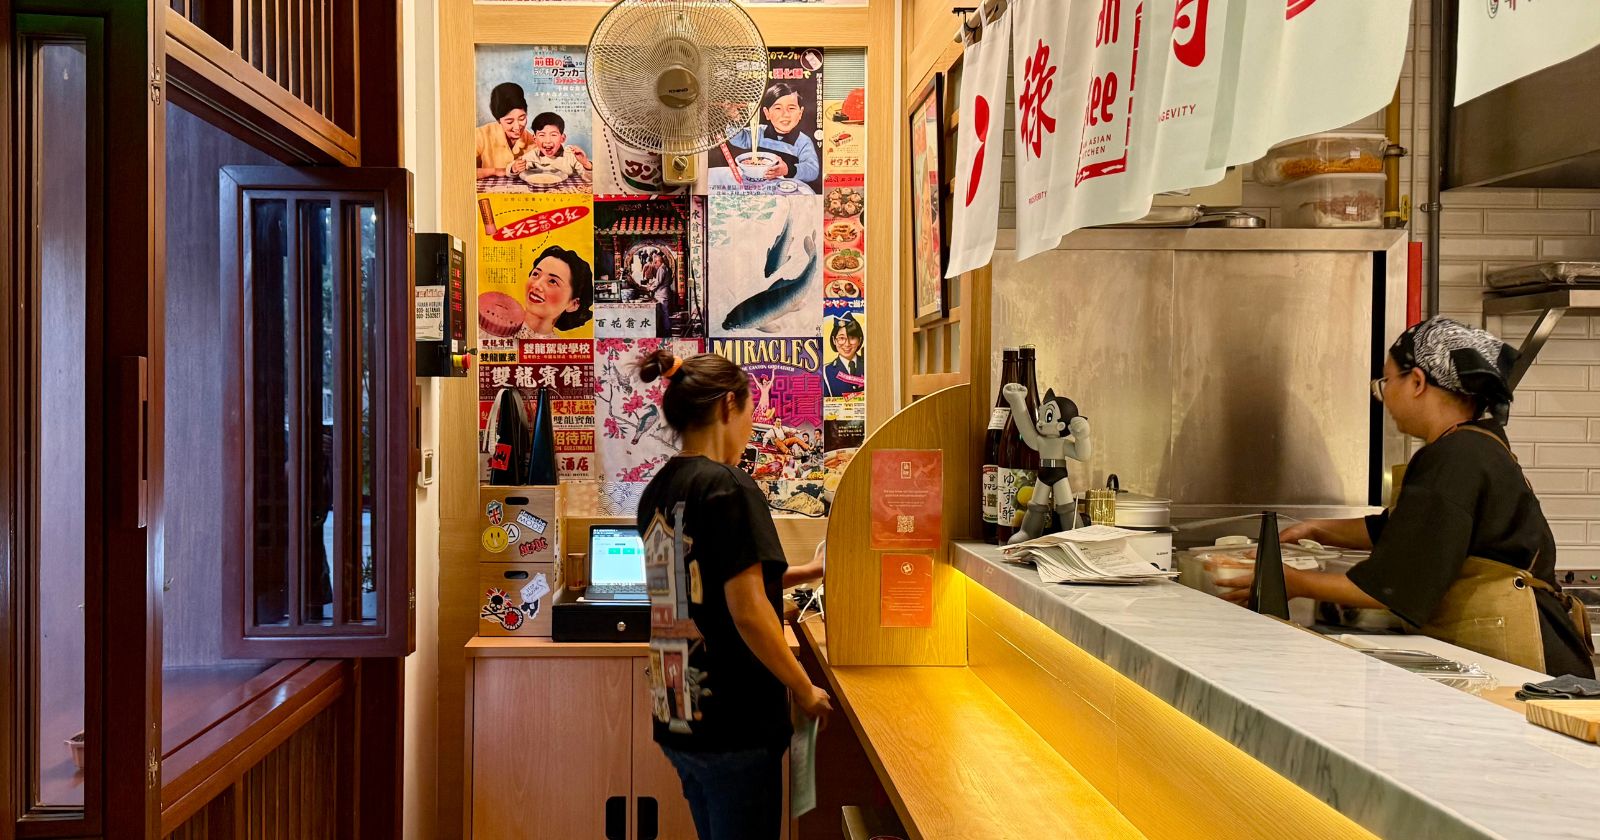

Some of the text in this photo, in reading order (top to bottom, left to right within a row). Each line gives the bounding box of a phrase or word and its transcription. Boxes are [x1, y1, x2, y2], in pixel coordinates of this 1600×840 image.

[534, 56, 562, 66] 前田の
[1088, 133, 1112, 146] ASIAN
[712, 338, 820, 372] MIRACLES
[490, 365, 584, 389] 雙龍賓館
[559, 456, 589, 471] 酒店
[517, 515, 544, 532] MODE
